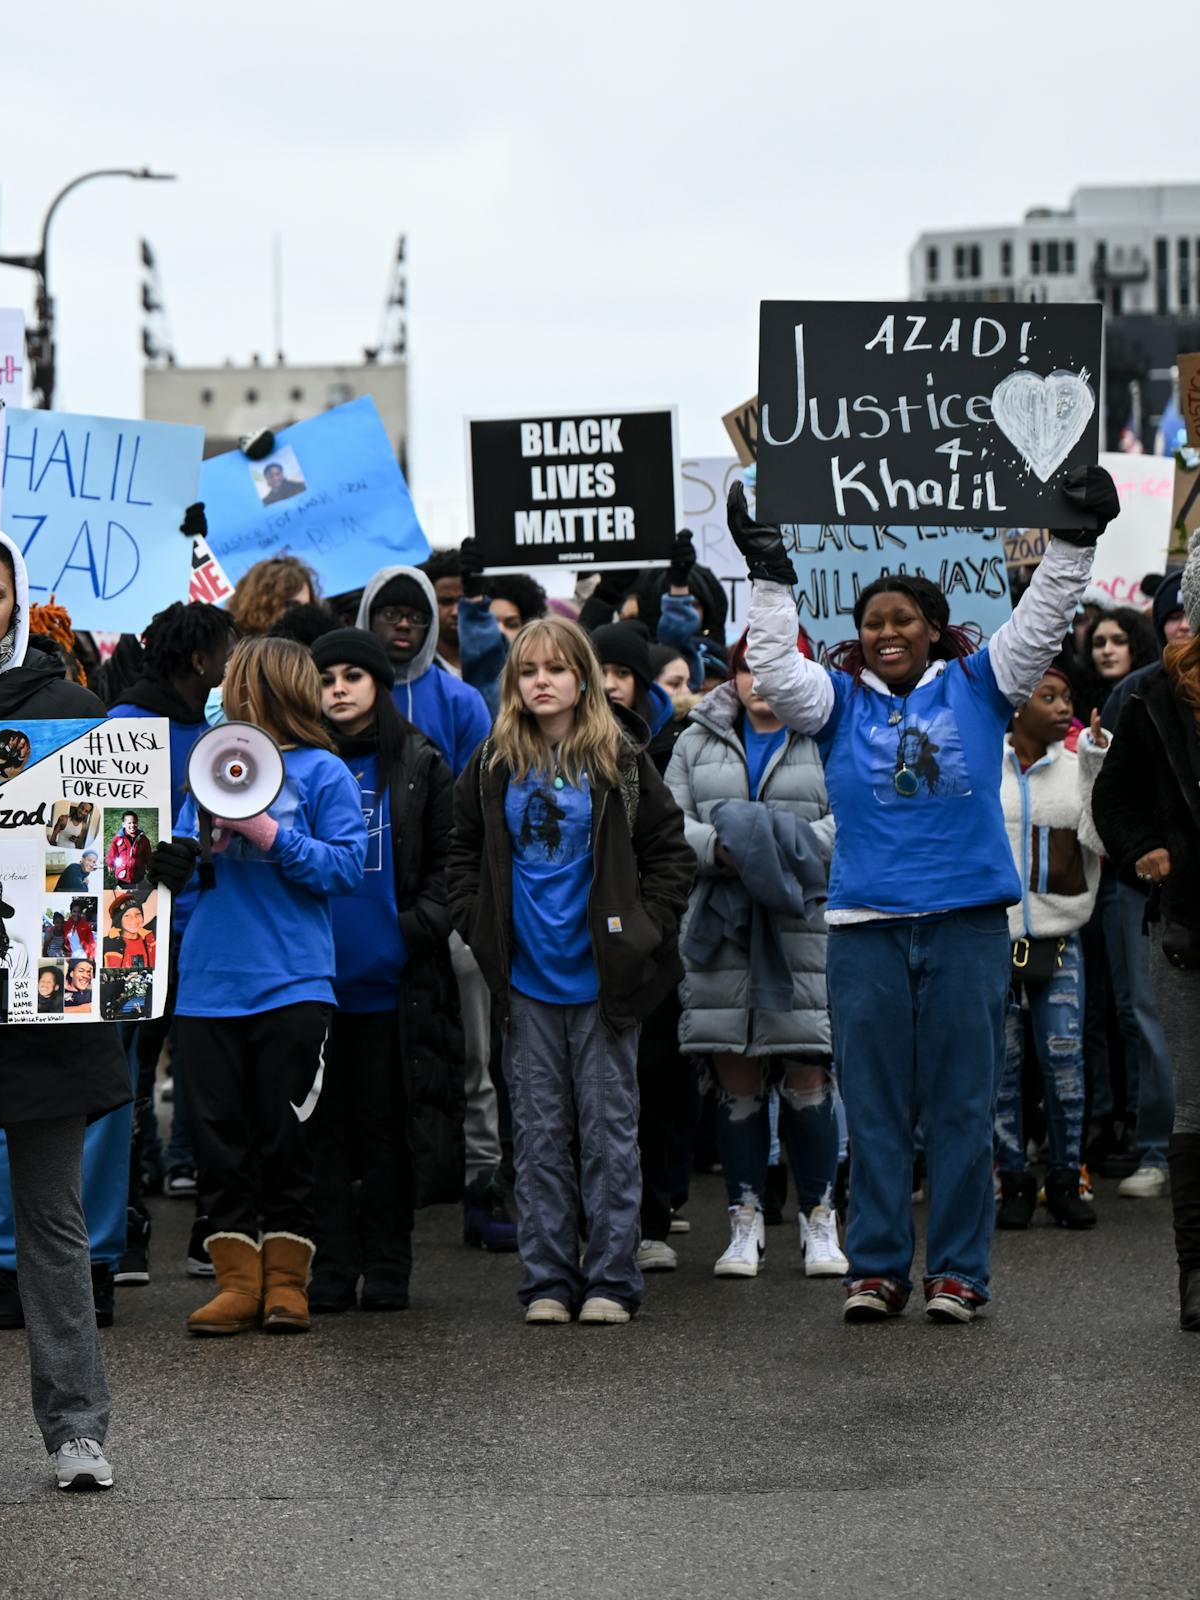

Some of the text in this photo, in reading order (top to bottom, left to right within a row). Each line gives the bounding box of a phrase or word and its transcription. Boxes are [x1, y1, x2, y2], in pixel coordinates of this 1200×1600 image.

[865, 314, 1031, 364] AZAD!
[761, 323, 996, 446] Justice
[520, 418, 623, 457] BLACK
[935, 437, 973, 471] 4
[2, 425, 152, 506] HALIL
[531, 462, 616, 501] LIVES
[514, 506, 636, 545] MATTER
[11, 514, 141, 600] ZAD
[83, 731, 165, 756] #LLKSL
[60, 755, 64, 774] I
[111, 758, 149, 775] YOU
[62, 780, 148, 799] FOREVER
[14, 981, 29, 990] SAY
[14, 991, 29, 999] HIS
